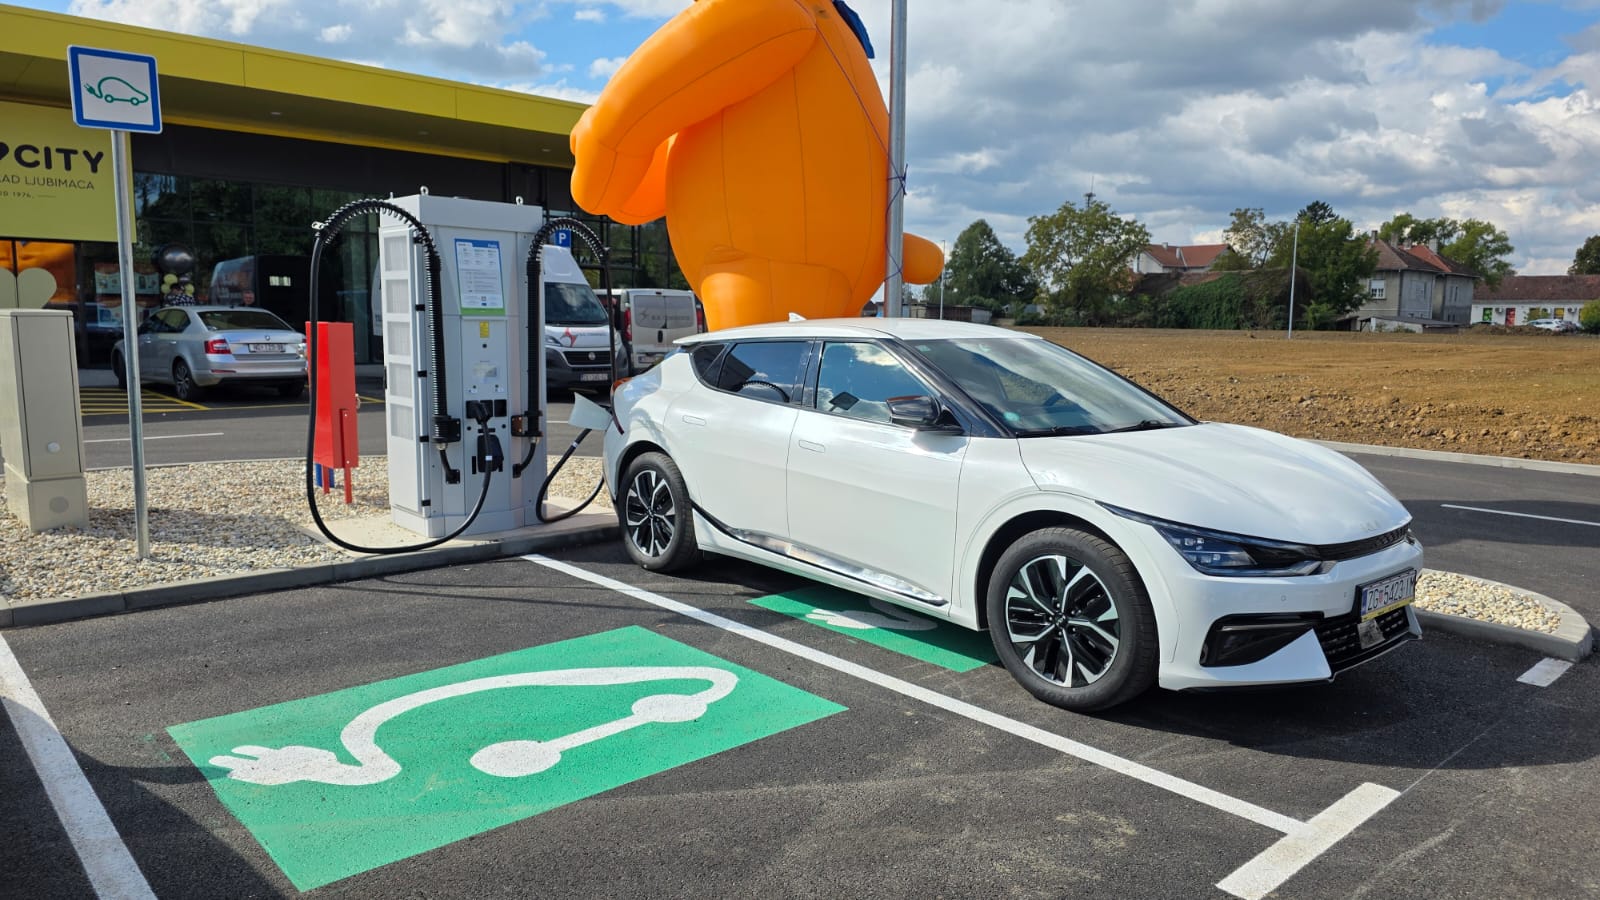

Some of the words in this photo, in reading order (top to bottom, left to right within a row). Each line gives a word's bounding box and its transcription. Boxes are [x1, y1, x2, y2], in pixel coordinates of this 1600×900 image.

[14, 144, 104, 174] CITY
[0, 174, 21, 185] AD
[25, 175, 95, 190] LJUBIMACA
[559, 233, 567, 243] P
